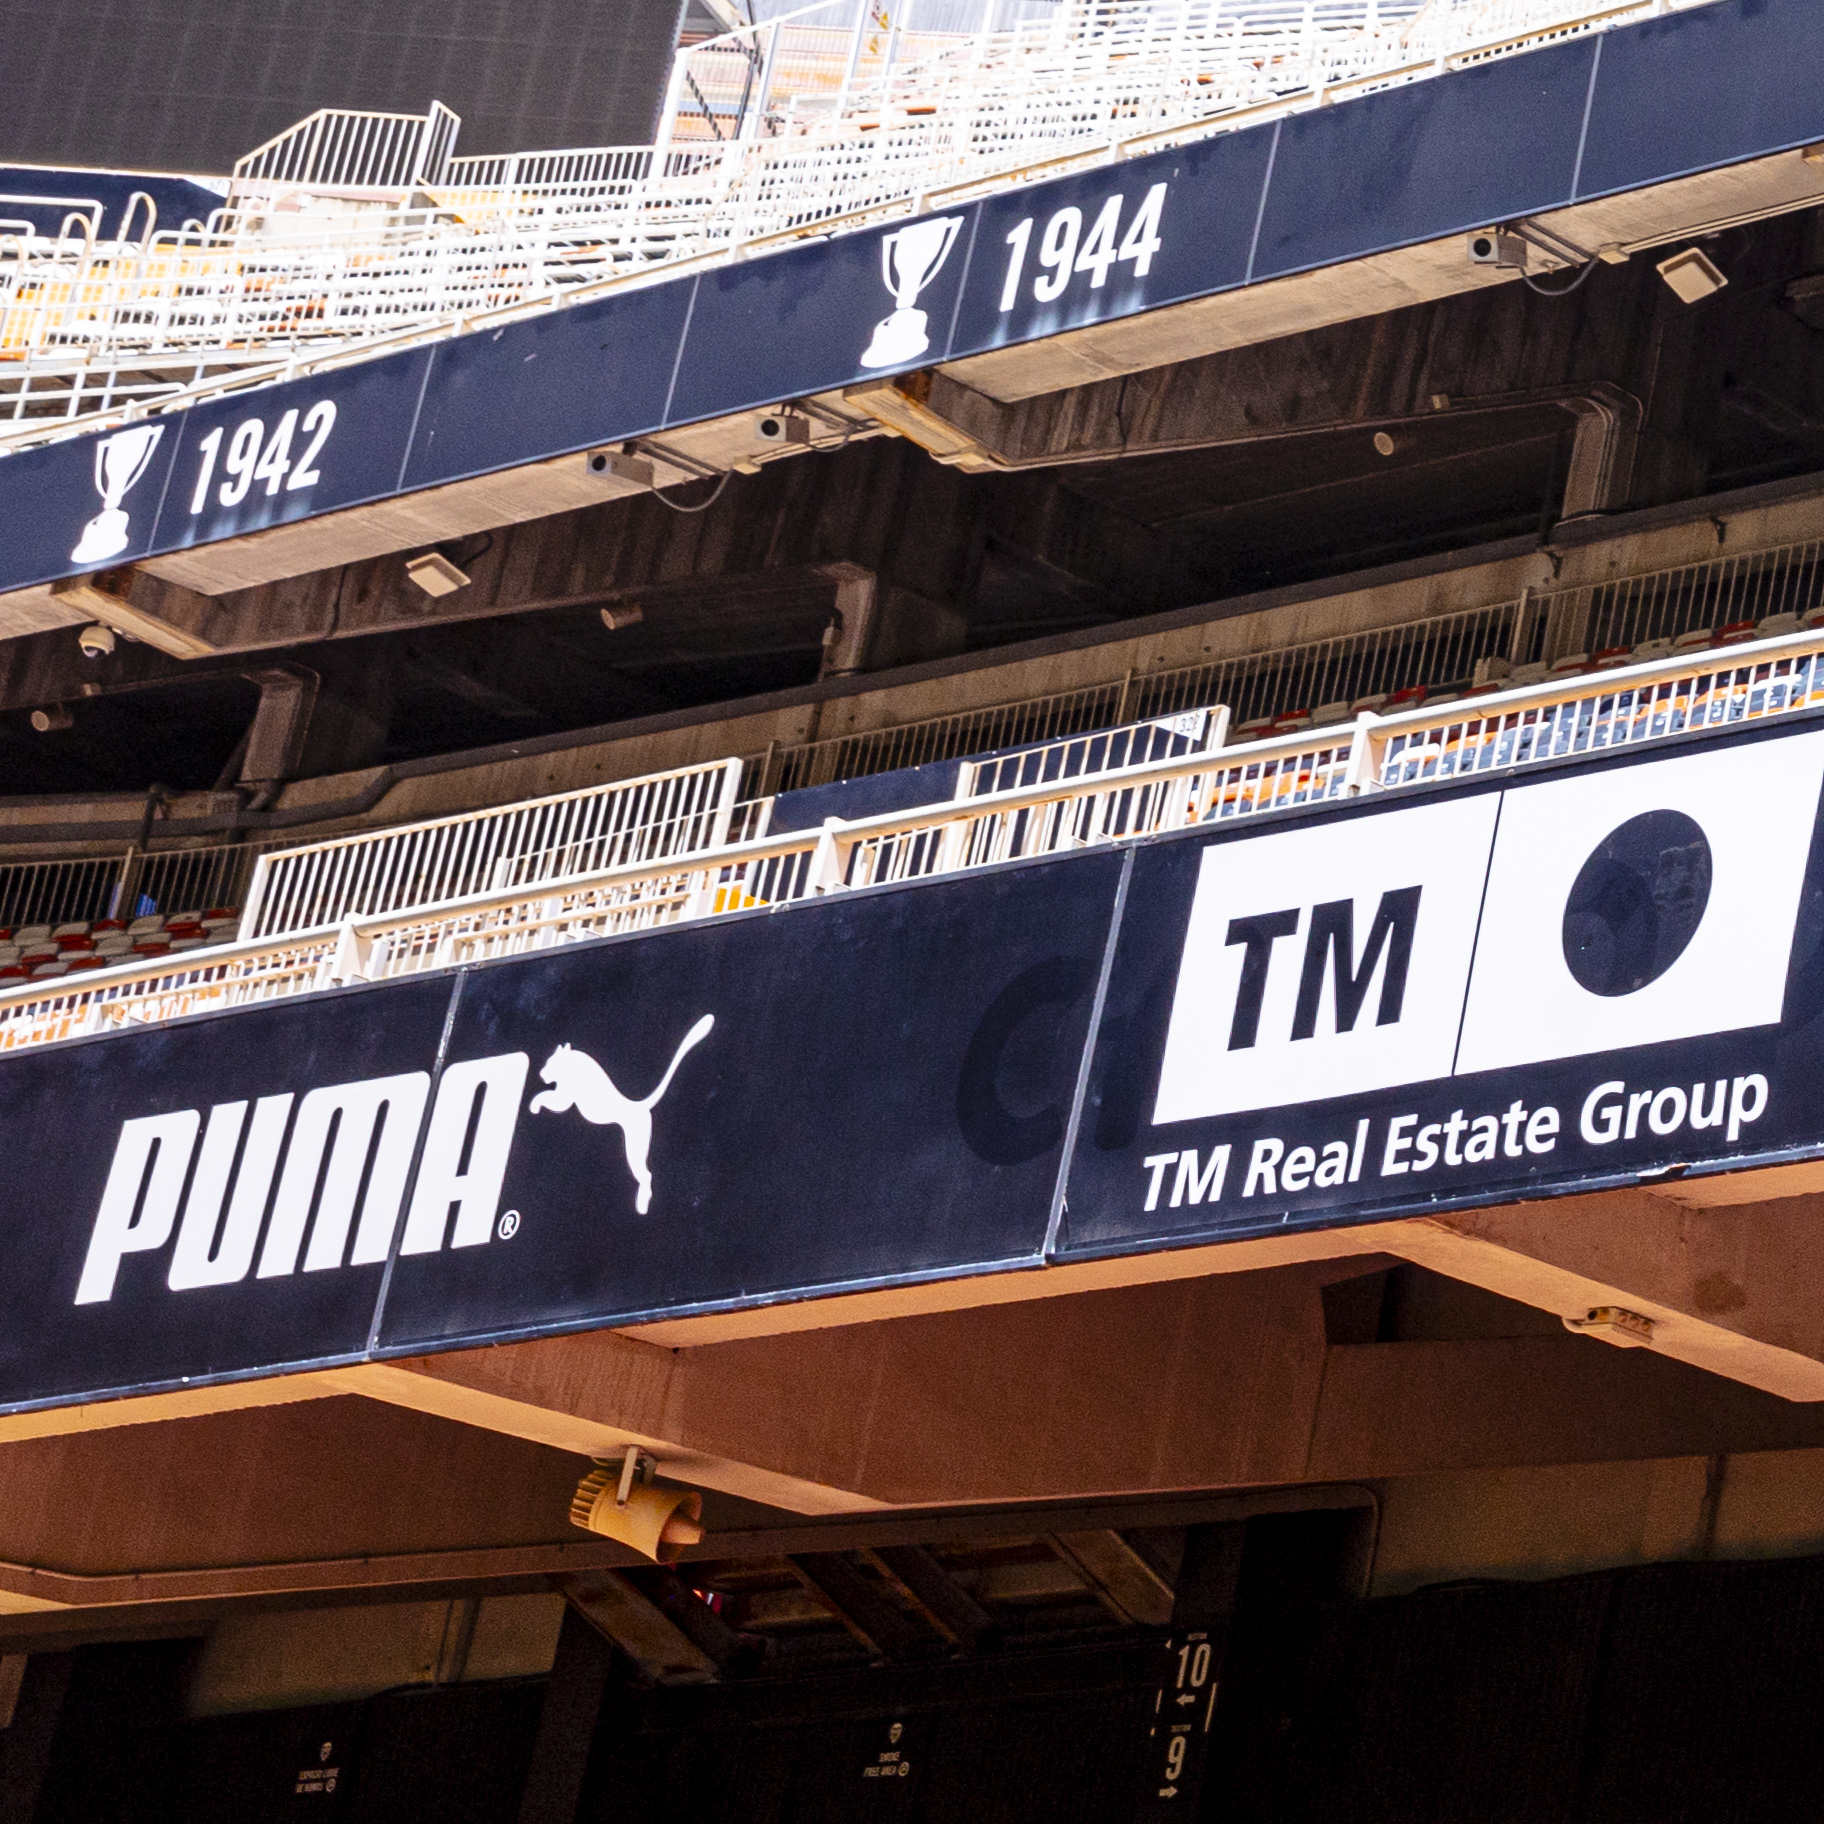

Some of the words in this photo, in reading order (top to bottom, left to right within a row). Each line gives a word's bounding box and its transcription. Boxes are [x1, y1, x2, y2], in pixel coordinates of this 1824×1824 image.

[1000, 183, 1167, 312] 1944
[191, 400, 336, 514] 1942
[1225, 885, 1422, 1051] TM
[75, 1052, 529, 1304] PUMA
[1144, 1145, 1231, 1211] TM
[1243, 1119, 1369, 1197] Real
[1381, 1100, 1559, 1176] Estate
[1581, 1074, 1768, 1140] Group
[1177, 1644, 1211, 1688] 10
[1166, 1736, 1186, 1780] 9
